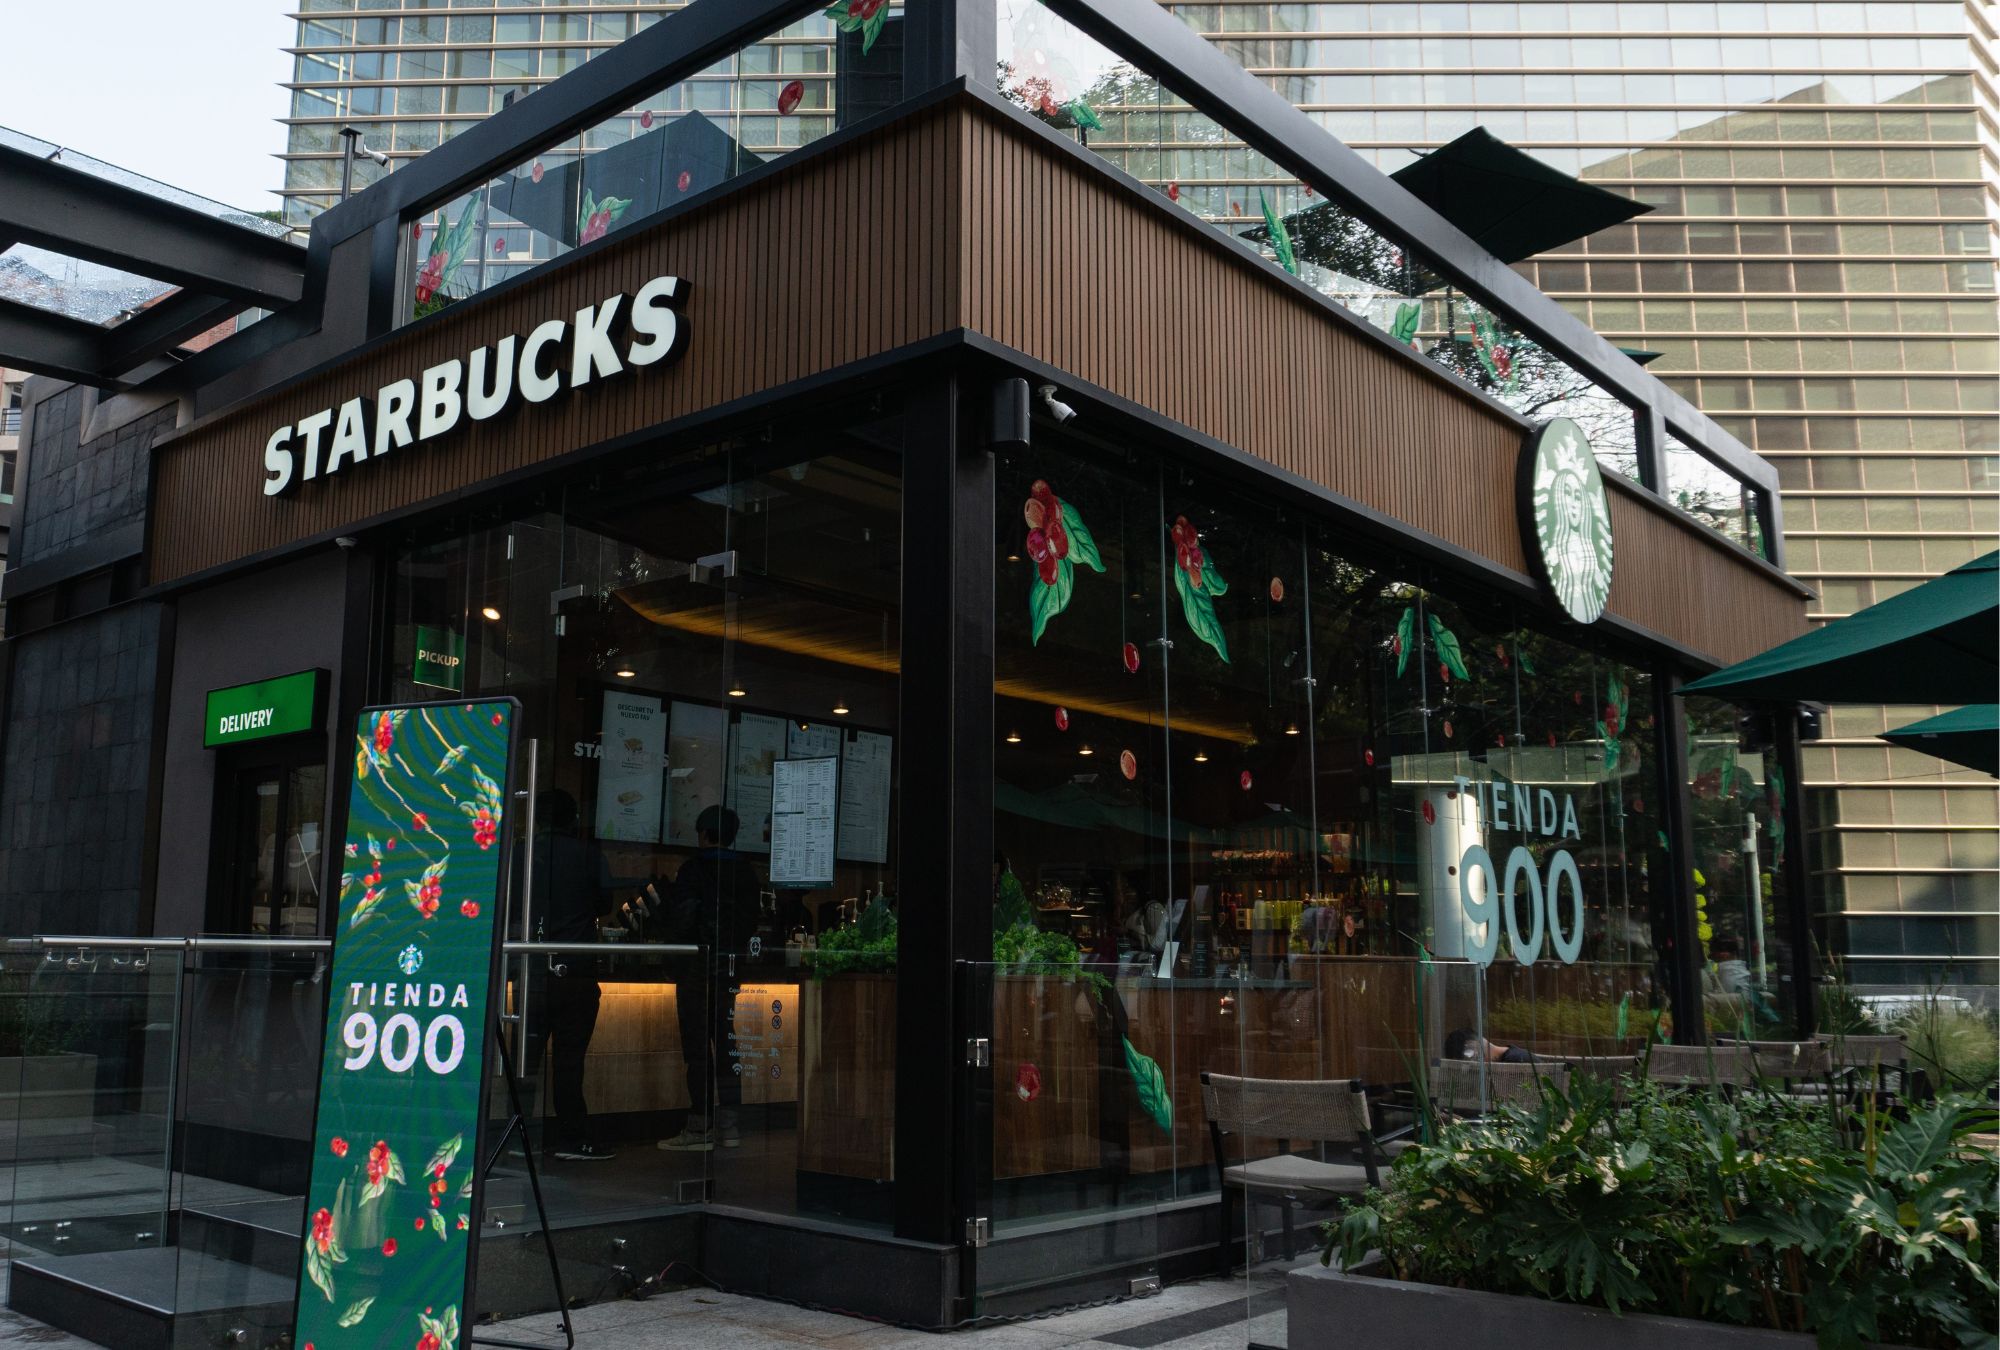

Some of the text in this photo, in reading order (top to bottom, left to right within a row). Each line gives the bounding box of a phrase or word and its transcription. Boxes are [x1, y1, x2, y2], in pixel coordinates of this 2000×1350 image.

[263, 275, 679, 497] STARBUCKS
[418, 649, 460, 668] PICKUP
[219, 707, 274, 735] DELIVERY
[620, 711, 640, 720] NUEVO
[646, 707, 655, 715] TU
[1453, 774, 1582, 841] TIENDA
[1459, 844, 1585, 969] 900
[350, 982, 469, 1008] TIENDA
[343, 1011, 466, 1075] 900
